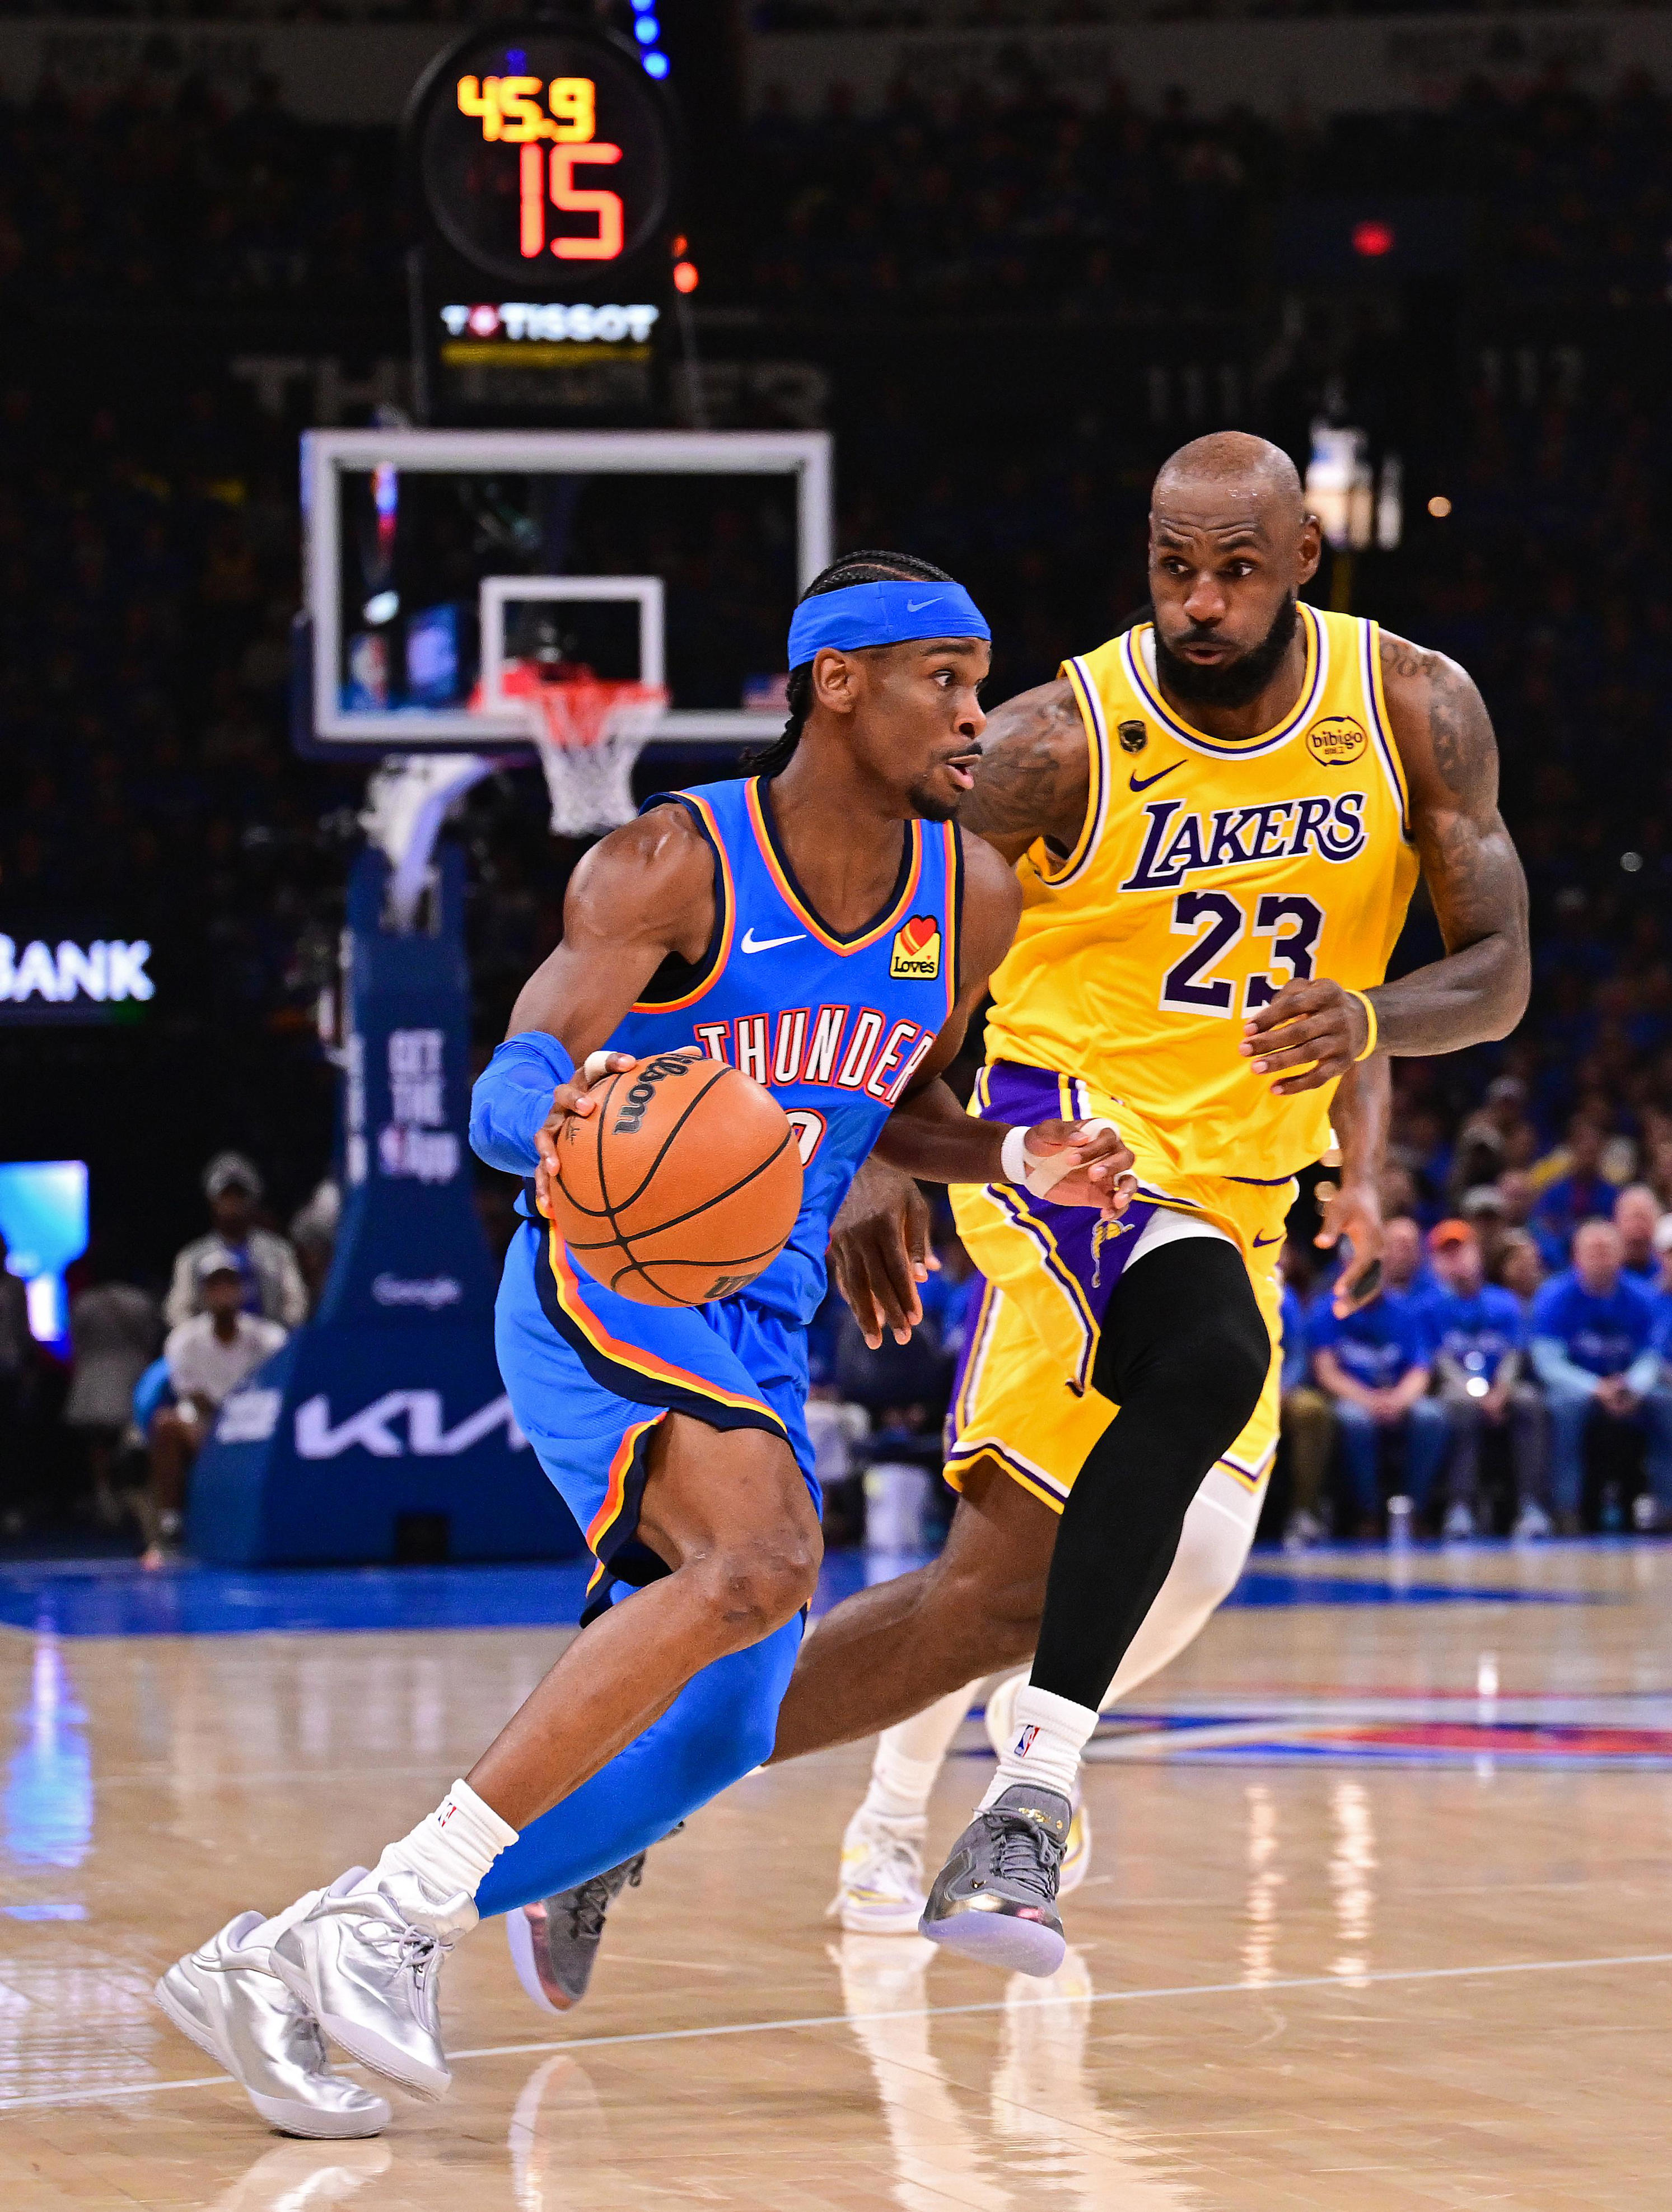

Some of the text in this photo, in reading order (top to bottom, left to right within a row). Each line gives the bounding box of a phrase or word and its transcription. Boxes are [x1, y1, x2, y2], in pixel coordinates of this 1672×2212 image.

[457, 75, 596, 142] 45.9
[520, 142, 624, 259] 15
[500, 302, 659, 343] TISSOT
[231, 355, 829, 428] THER
[1312, 729, 1362, 749] bibigo
[1118, 791, 1369, 892] LAKERS
[1158, 888, 1326, 1020] 23
[612, 1053, 707, 1135] ilson
[693, 1005, 938, 1108] THUNDER
